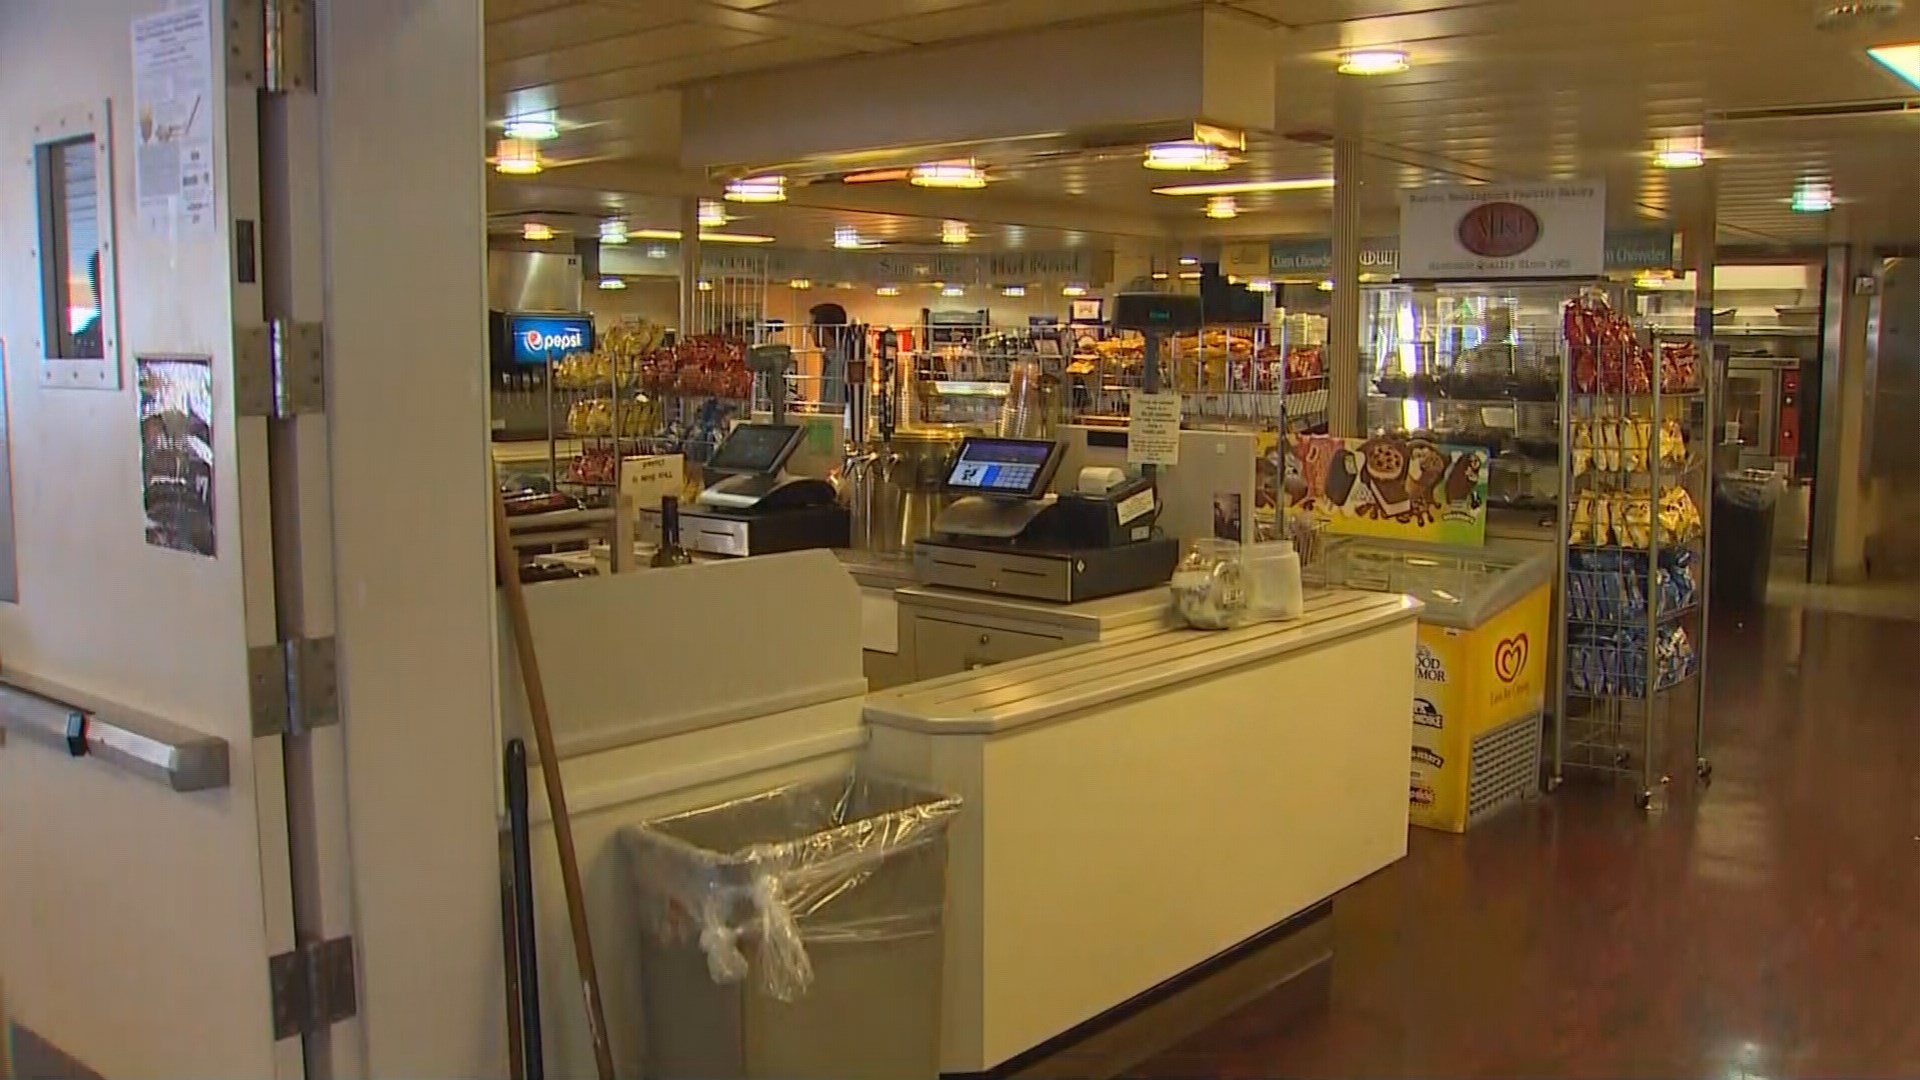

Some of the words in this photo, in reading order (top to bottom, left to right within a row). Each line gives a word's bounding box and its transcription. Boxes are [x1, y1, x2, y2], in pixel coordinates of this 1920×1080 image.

[1295, 251, 1333, 268] Chowde
[544, 333, 582, 351] pepsi
[1415, 656, 1441, 670] OOD
[1415, 667, 1446, 683] MOR
